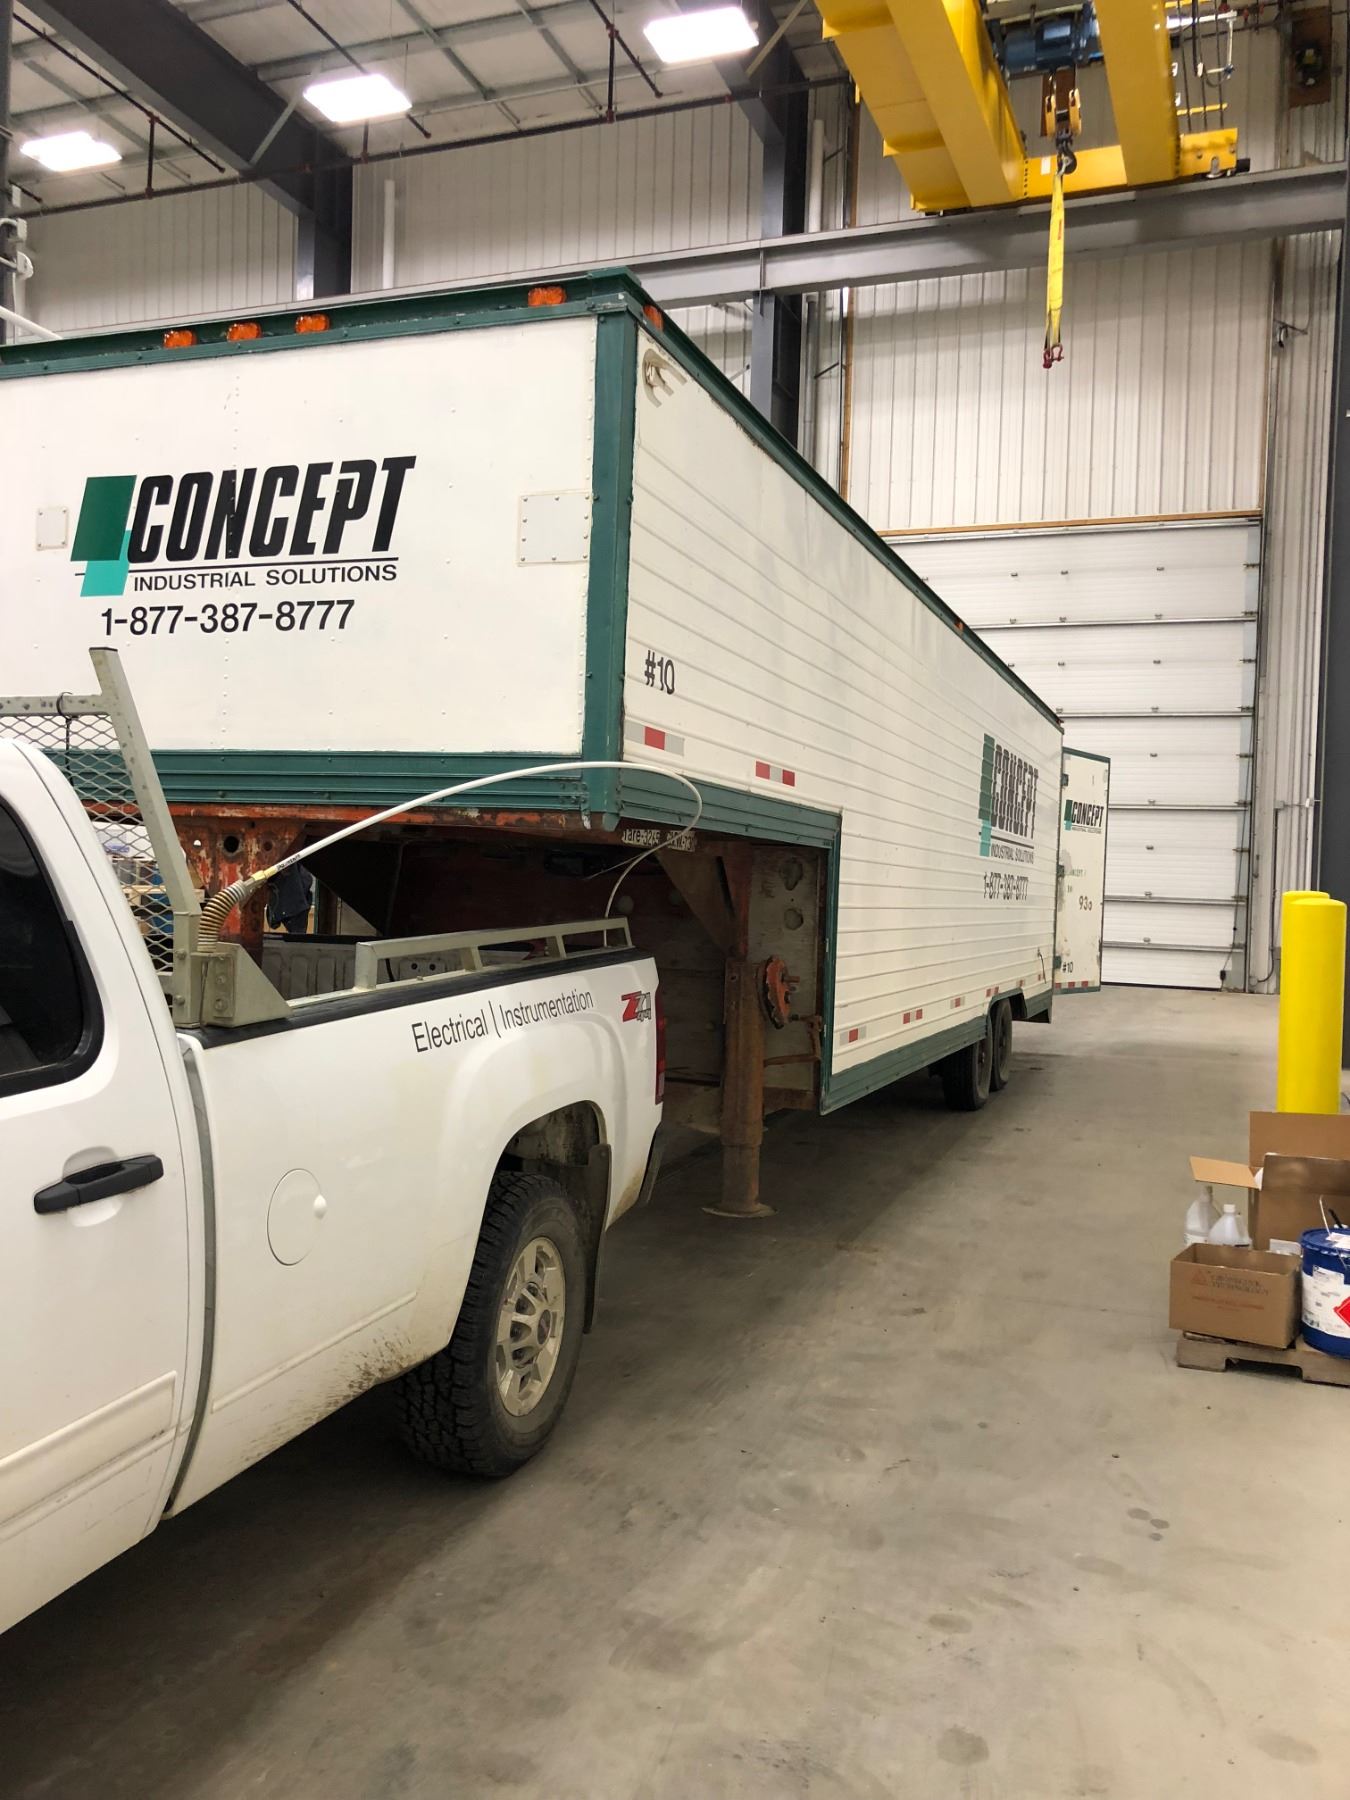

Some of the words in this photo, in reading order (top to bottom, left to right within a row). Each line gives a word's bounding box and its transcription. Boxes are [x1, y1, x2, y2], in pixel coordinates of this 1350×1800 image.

[127, 456, 416, 564] CONCEPT
[134, 571, 256, 592] INDUSTRIAL
[266, 564, 397, 586] SOLUTIONS
[101, 599, 355, 636] 1-877-387-8777
[644, 650, 675, 695] #10
[990, 744, 1038, 839] CONCEPT
[1071, 801, 1104, 828] CONCEPT
[1062, 962, 1074, 974] #10
[411, 1009, 489, 1053] Electrical
[499, 989, 594, 1030] Instrumentation
